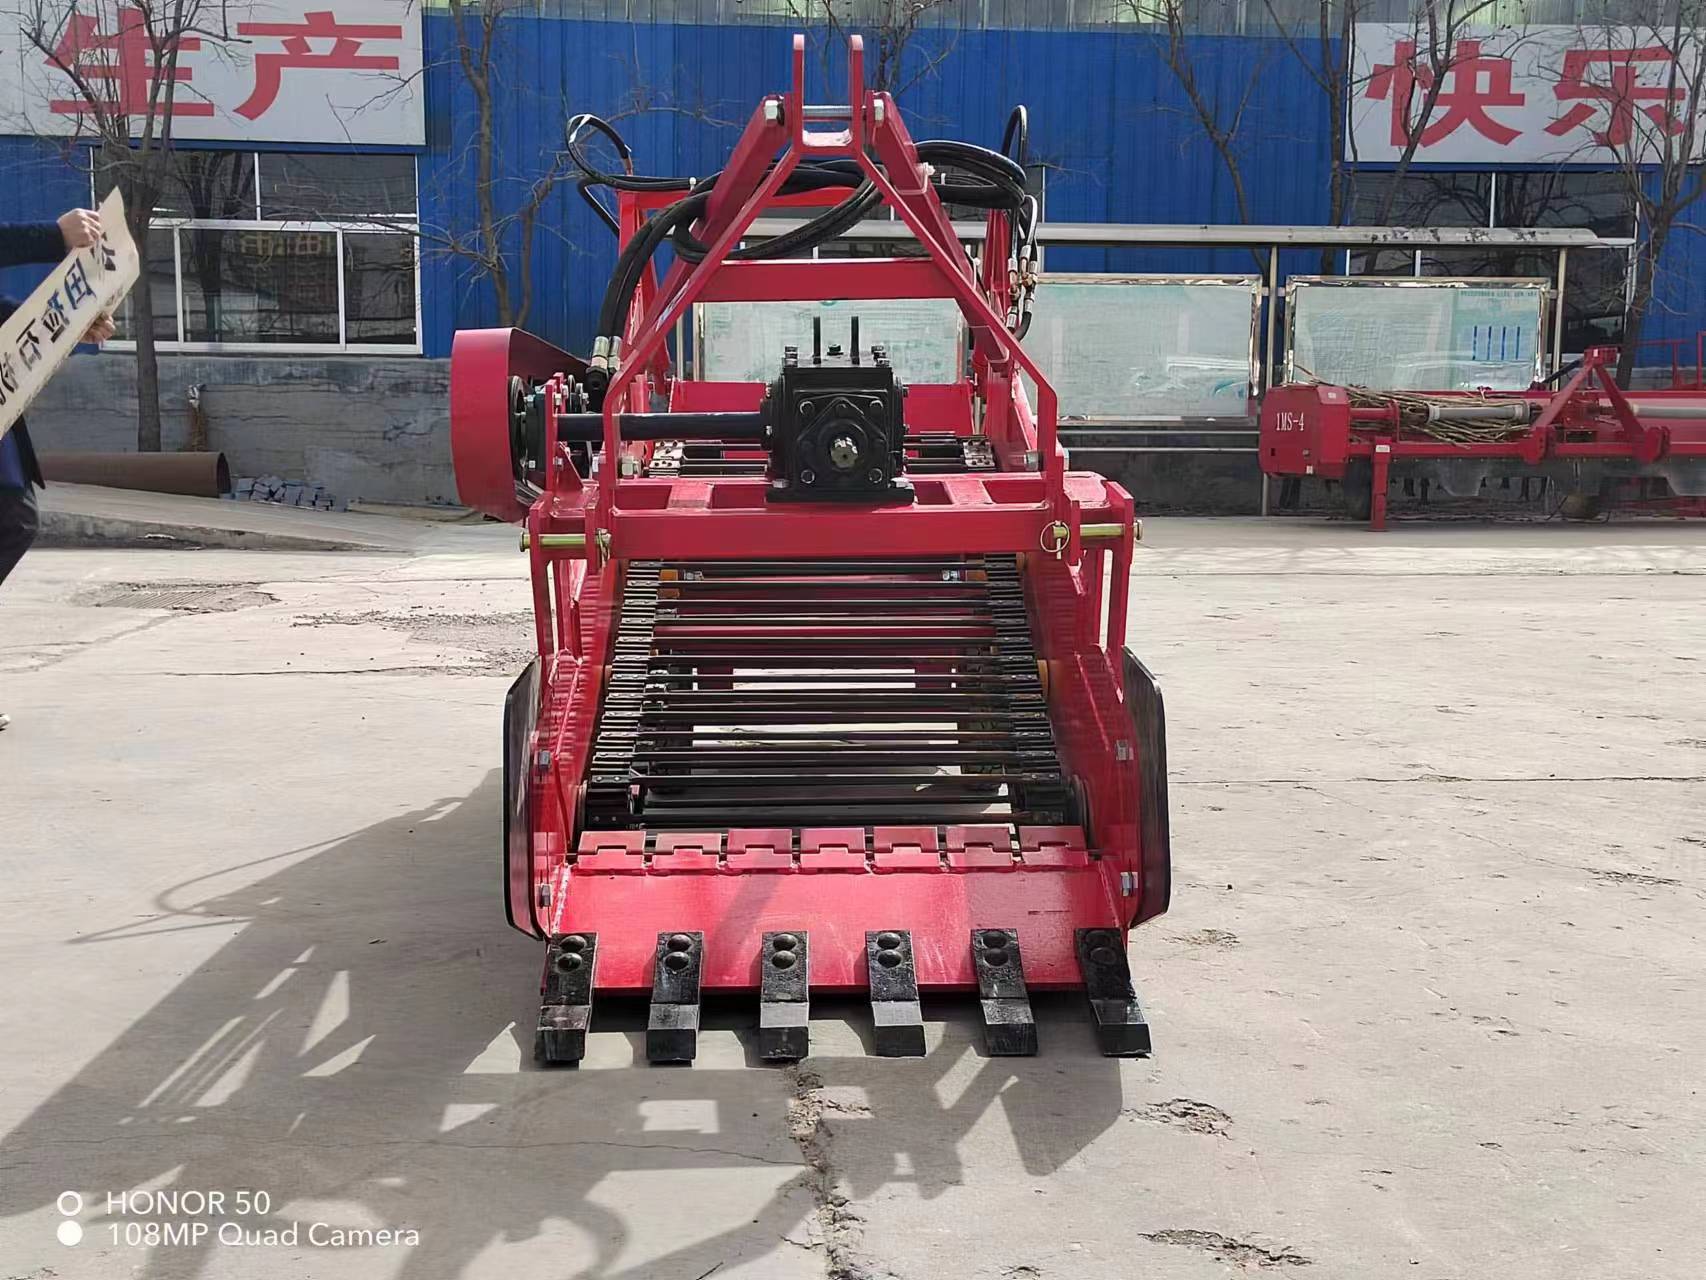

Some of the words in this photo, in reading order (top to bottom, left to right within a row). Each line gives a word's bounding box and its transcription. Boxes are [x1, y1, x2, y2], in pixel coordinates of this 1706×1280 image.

[44, 8, 403, 120] 生产
[1365, 40, 1687, 147] 快乐
[1276, 412, 1304, 431] 1MS-4
